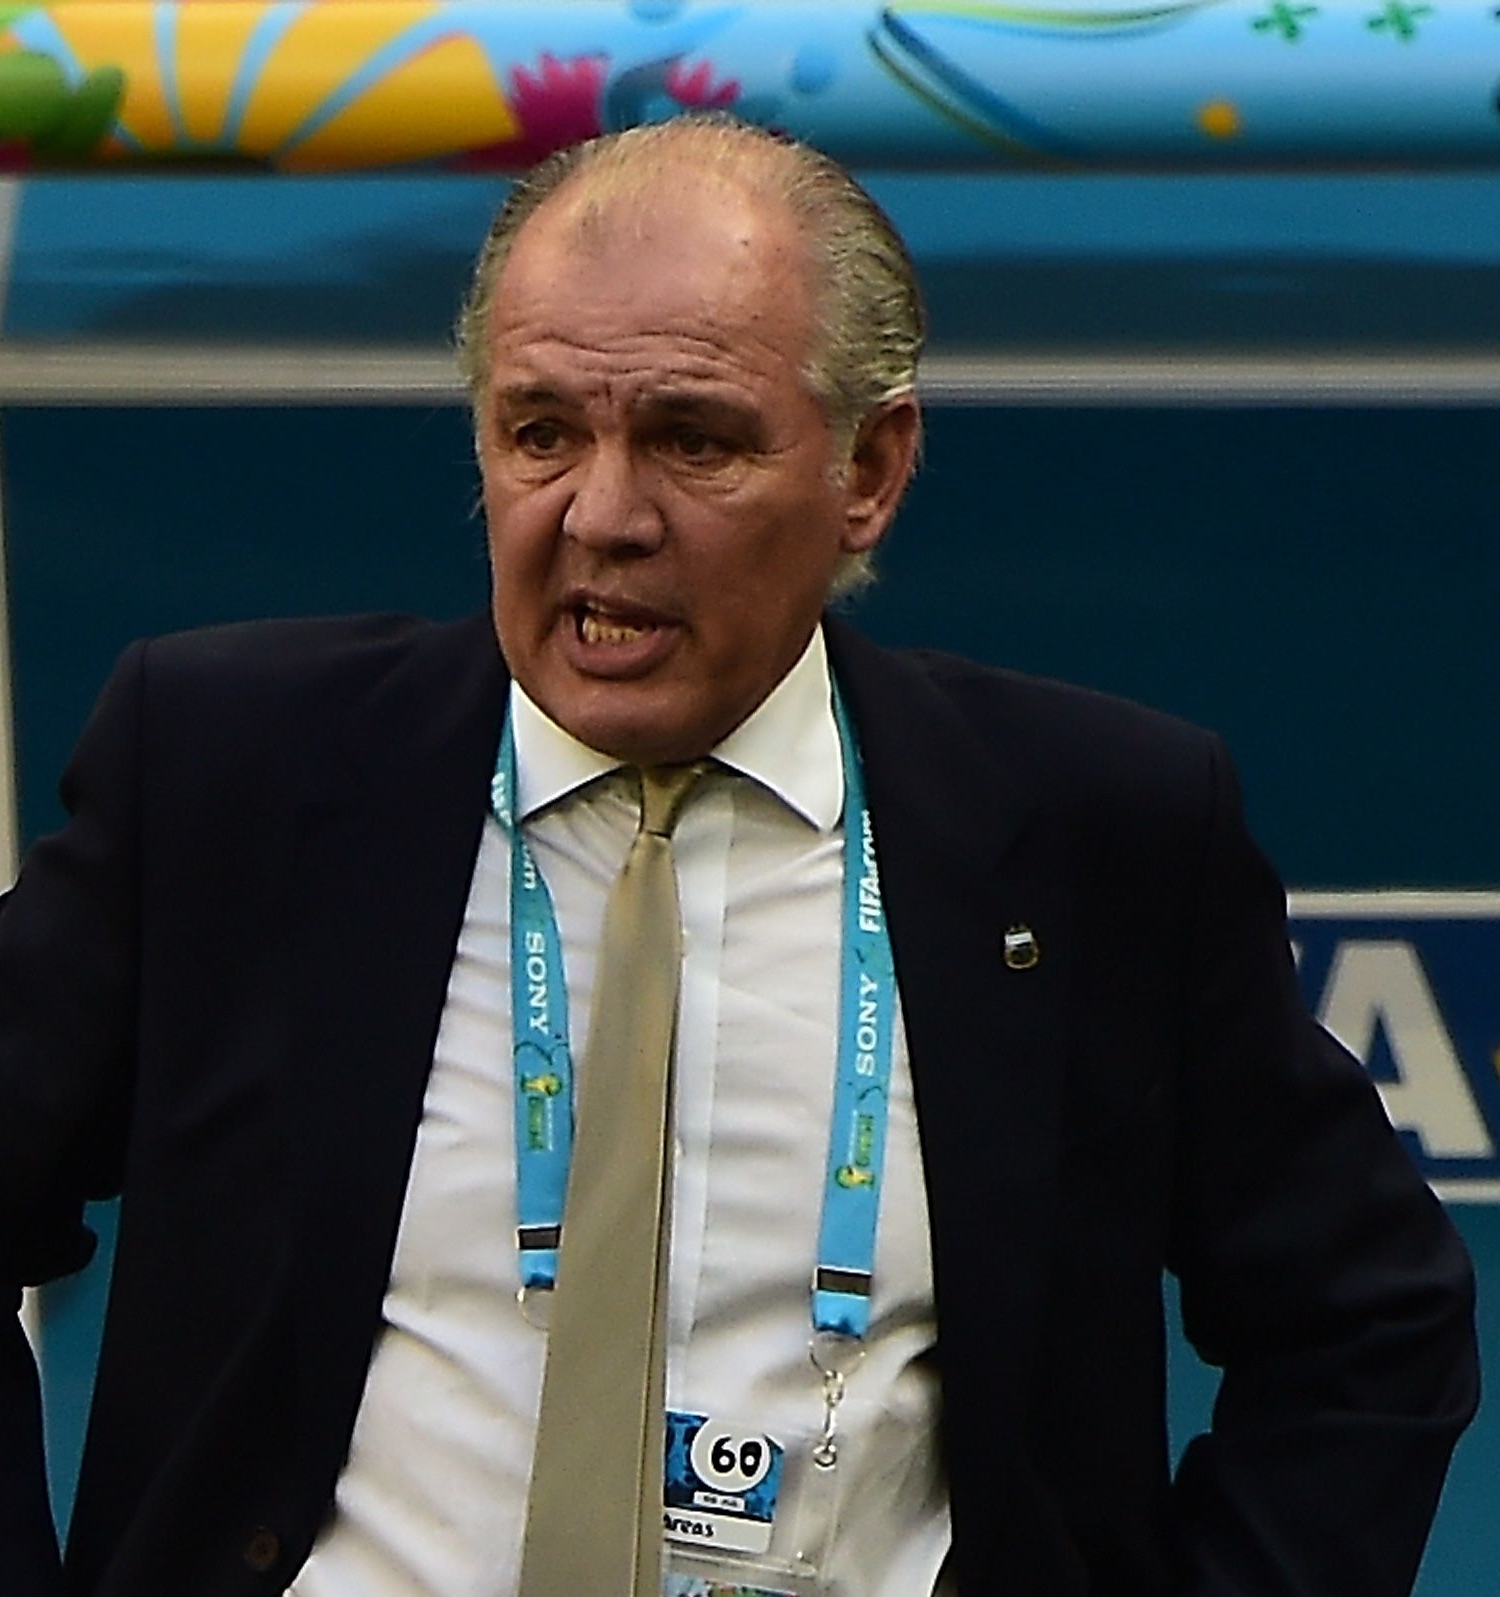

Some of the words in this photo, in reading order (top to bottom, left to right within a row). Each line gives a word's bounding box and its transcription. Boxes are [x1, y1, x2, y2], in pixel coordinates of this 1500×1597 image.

[523, 930, 550, 1036] SONY
[855, 972, 880, 1077] SONY
[1290, 938, 1496, 1160] A
[710, 1436, 763, 1478] 60
